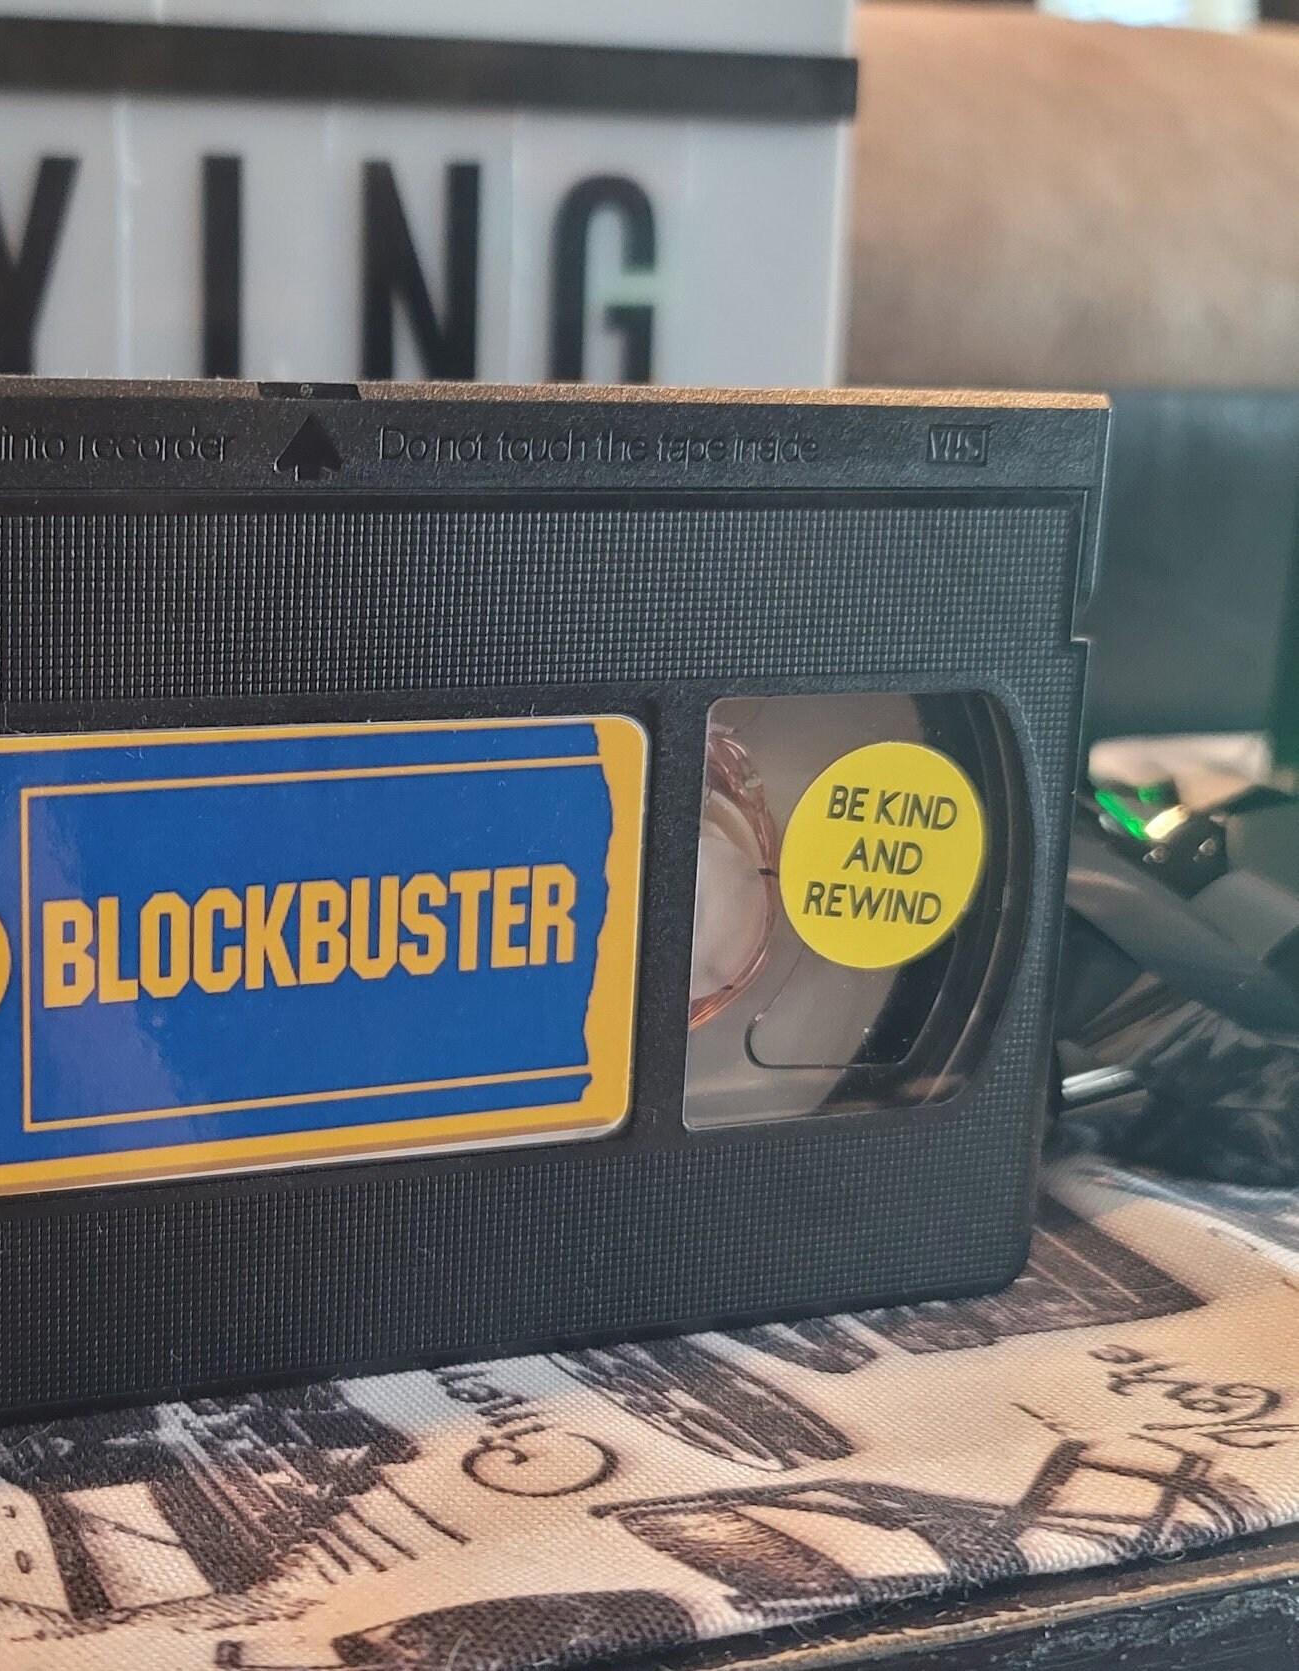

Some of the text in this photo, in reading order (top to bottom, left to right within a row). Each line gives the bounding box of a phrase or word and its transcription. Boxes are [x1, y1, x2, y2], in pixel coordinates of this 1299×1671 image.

[0, 425, 66, 463] into
[78, 425, 236, 464] recorder
[378, 426, 820, 471] Do not touch the tape inside
[929, 429, 982, 461] VHS
[826, 784, 958, 832] BE KIND
[841, 836, 924, 877] AND
[802, 880, 942, 926] REWIND
[42, 862, 578, 1010] BLOCKBUSTER
